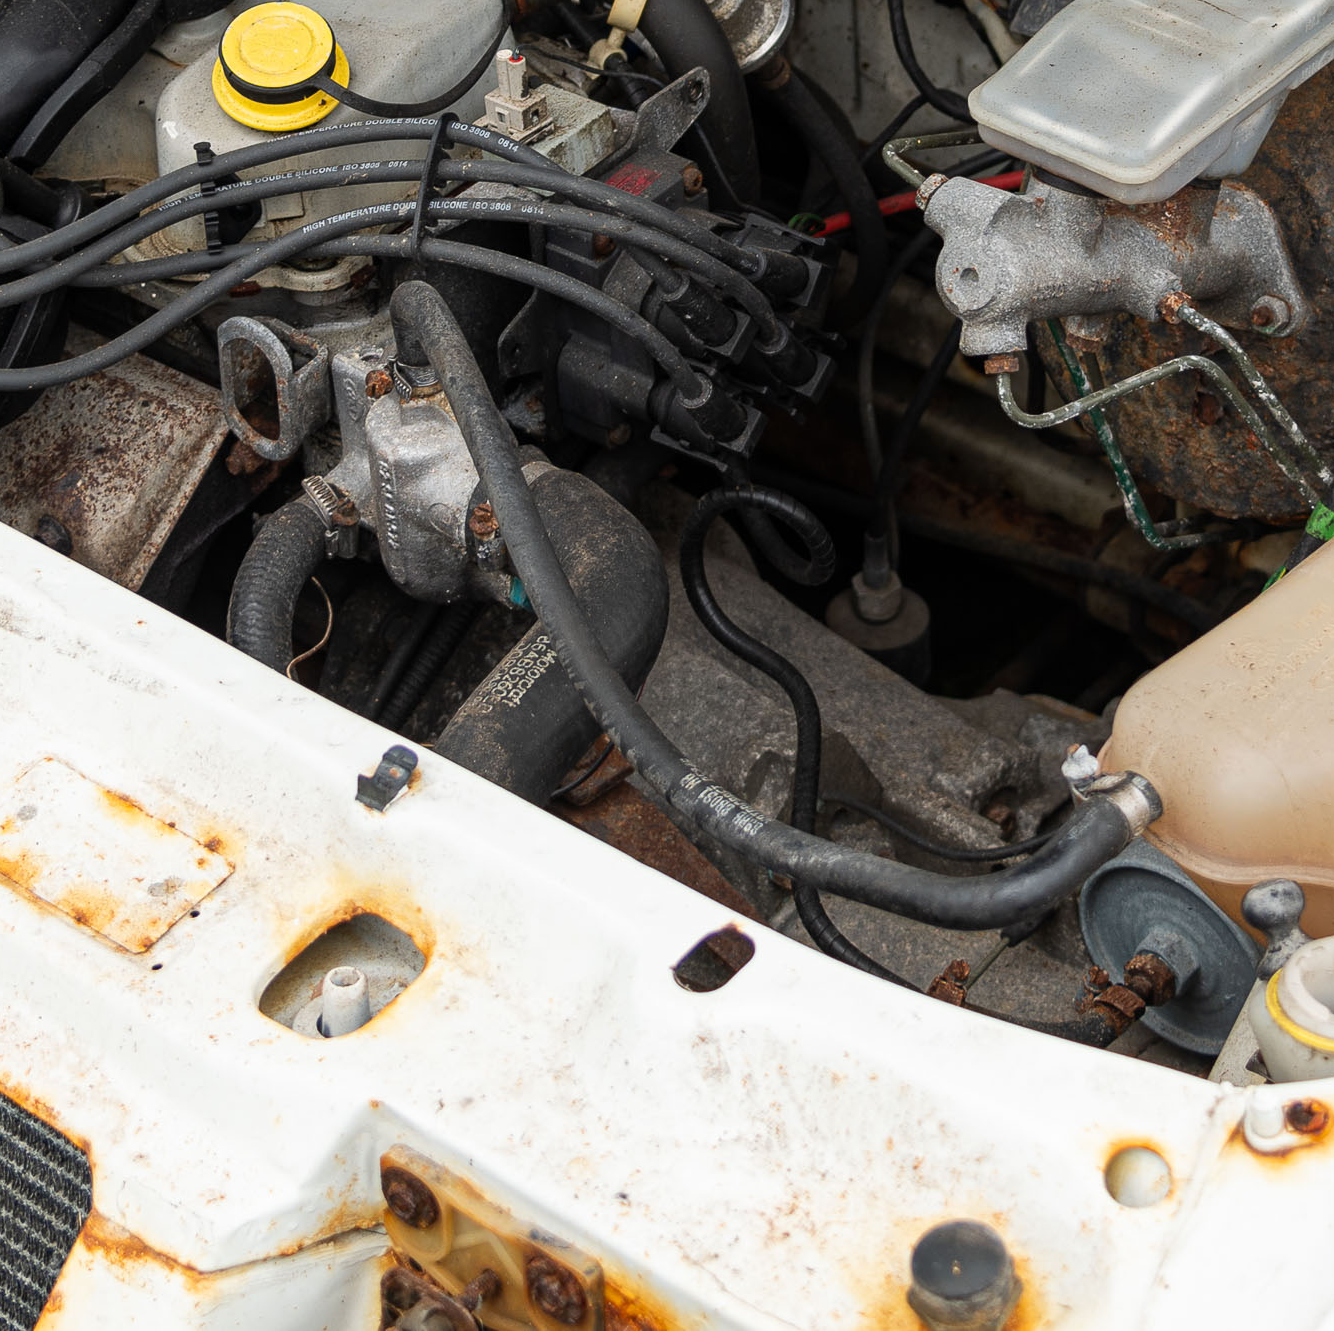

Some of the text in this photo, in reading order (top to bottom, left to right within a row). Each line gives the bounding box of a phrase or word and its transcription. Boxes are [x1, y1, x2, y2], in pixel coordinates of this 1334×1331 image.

[451, 120, 468, 131] ISO
[497, 137, 520, 153] 0814
[255, 170, 293, 184] DOUBLE
[296, 165, 338, 179] SILICONE
[341, 163, 358, 172] ISO
[302, 219, 327, 234] HIGH
[328, 203, 391, 225] TEMPERATURE
[428, 201, 468, 211] SILICONE
[471, 201, 488, 211] ISO
